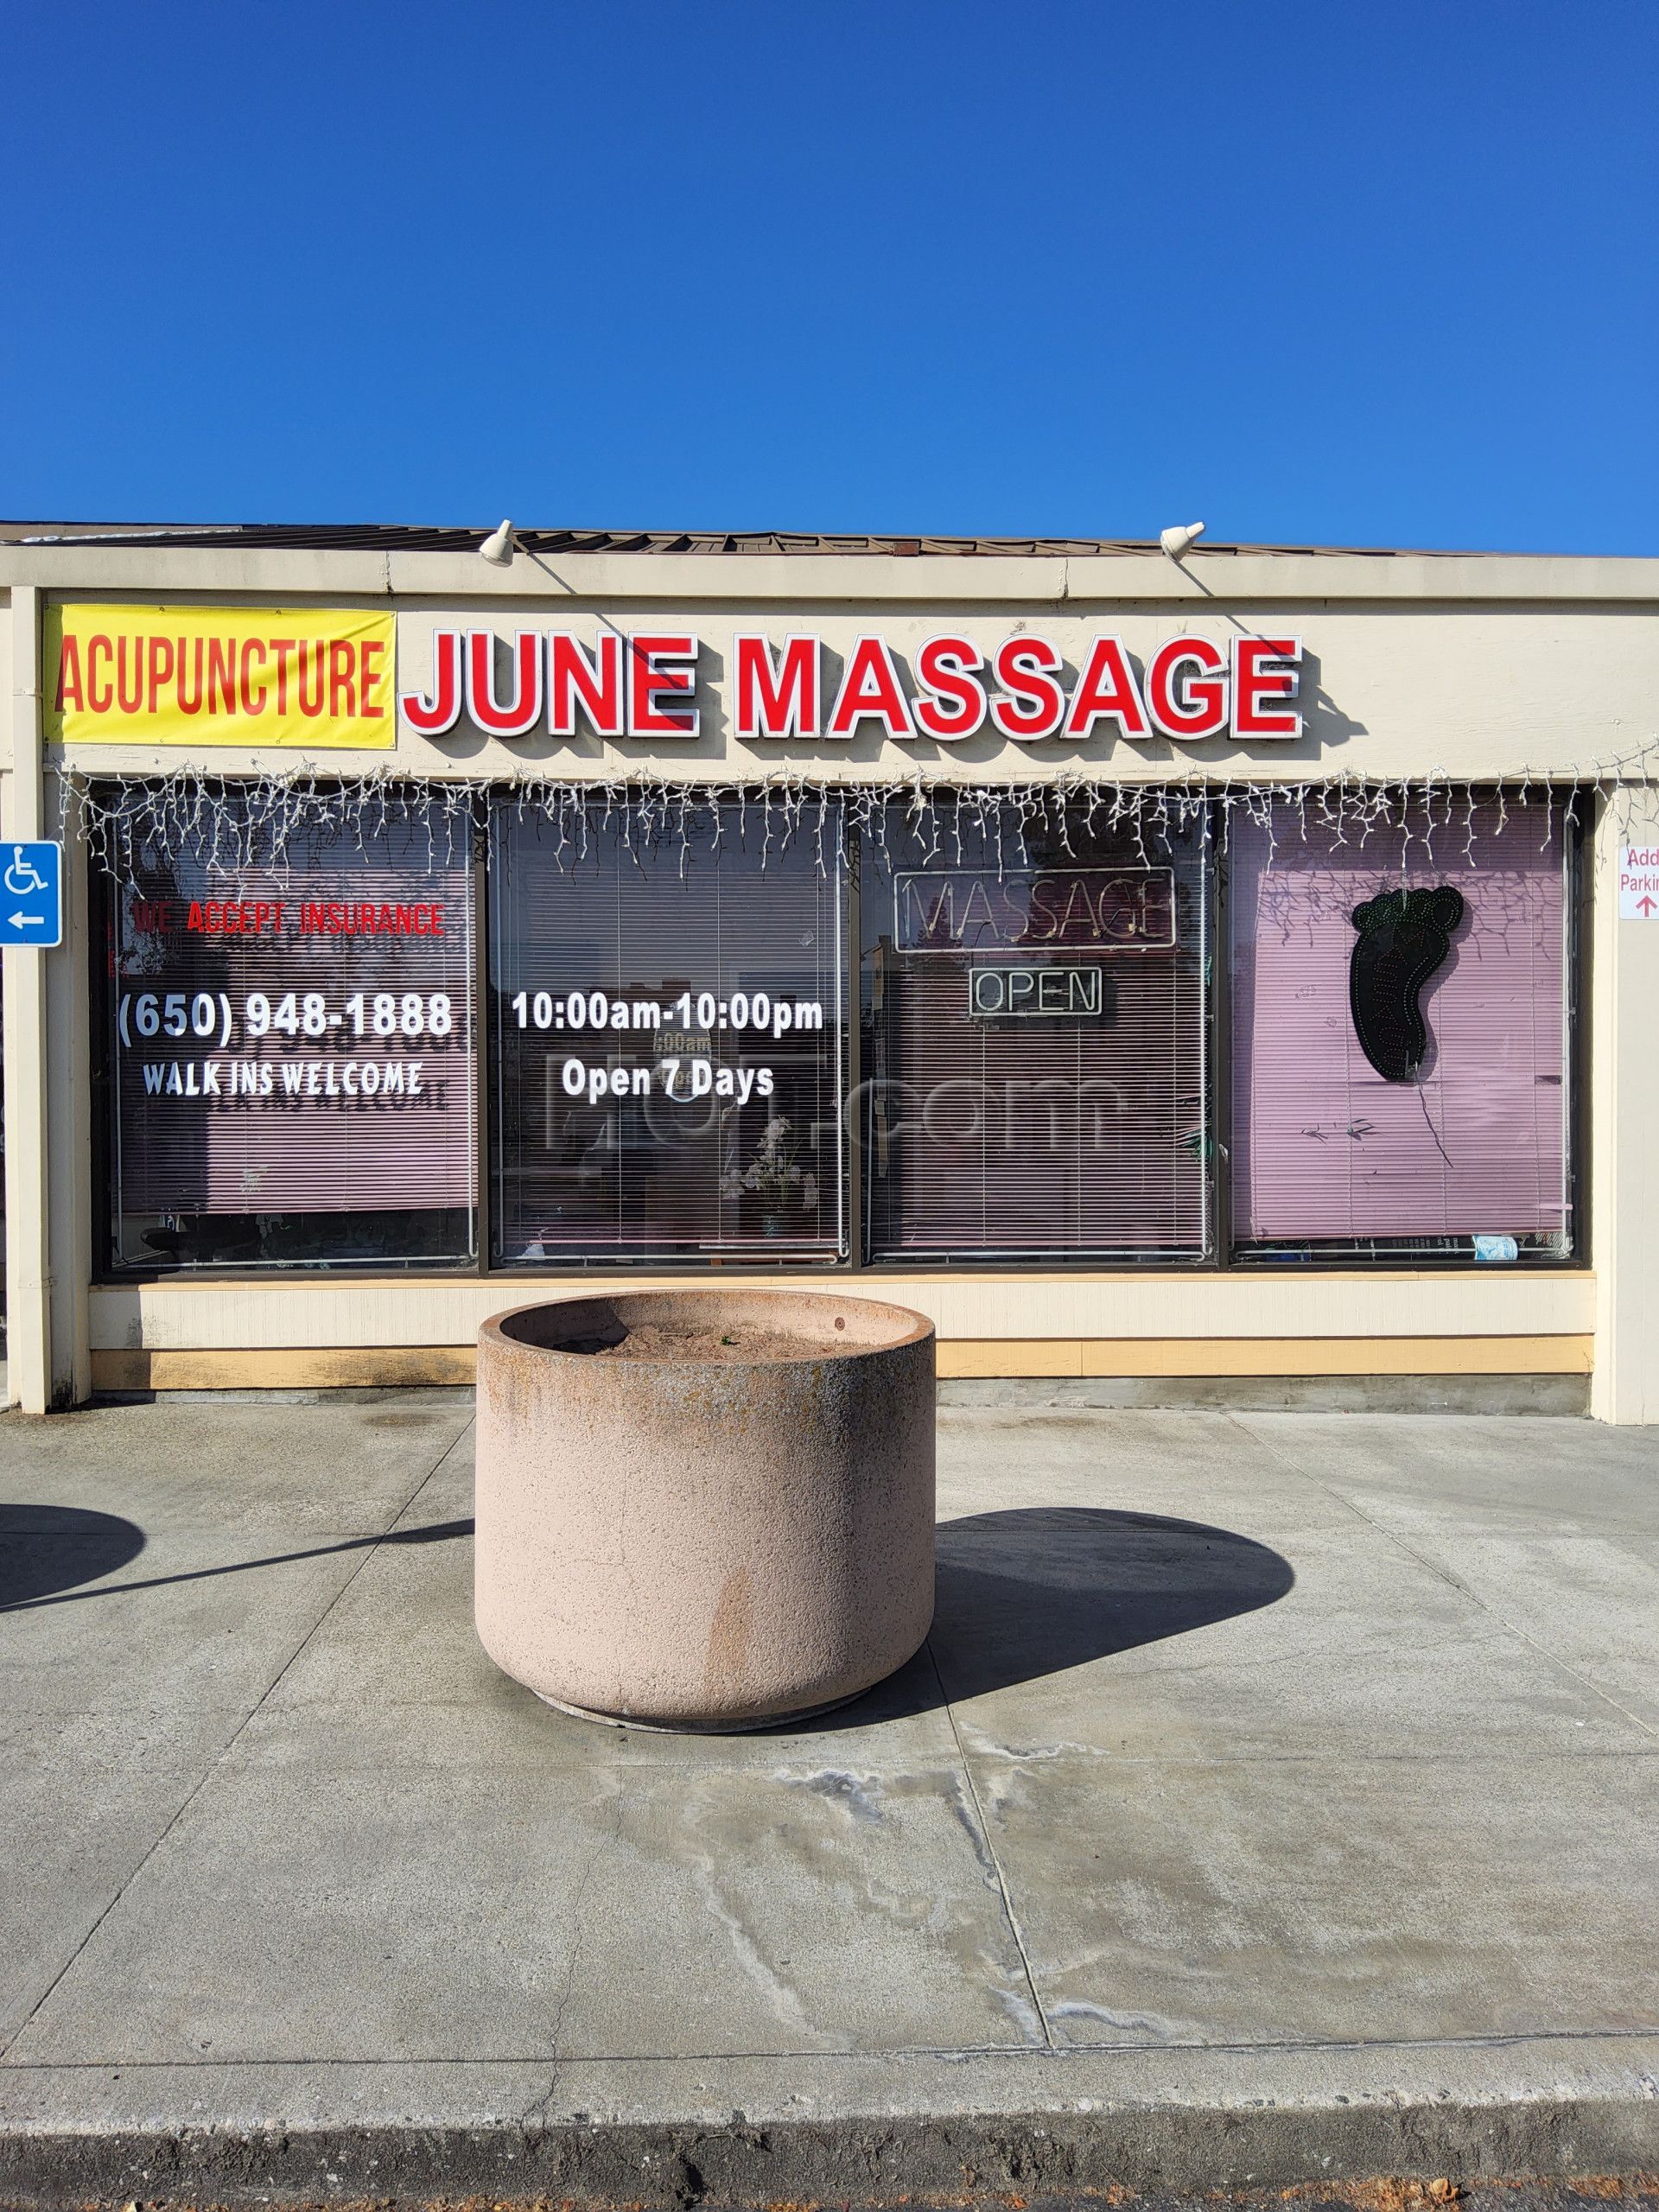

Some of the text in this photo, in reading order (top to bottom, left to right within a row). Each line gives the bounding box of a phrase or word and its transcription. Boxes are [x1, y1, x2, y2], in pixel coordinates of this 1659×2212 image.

[54, 633, 385, 719] ACUPUNCTURE
[398, 628, 1303, 741] JUNE MASSAGE
[1621, 874, 1659, 891] Parki
[132, 900, 175, 933] WE
[188, 900, 286, 934] ACCEPT
[300, 902, 445, 936] INSURANCE
[902, 878, 1165, 942] MASSAGE
[976, 971, 1096, 1011] OPEN
[118, 992, 452, 1047] (650) 948-1888
[512, 991, 823, 1039] 10:00am-10:00pm
[143, 1061, 423, 1096] WALK INS WELCOME
[563, 1058, 651, 1104] Open
[660, 1059, 681, 1095] 7
[692, 1059, 774, 1104] Days
